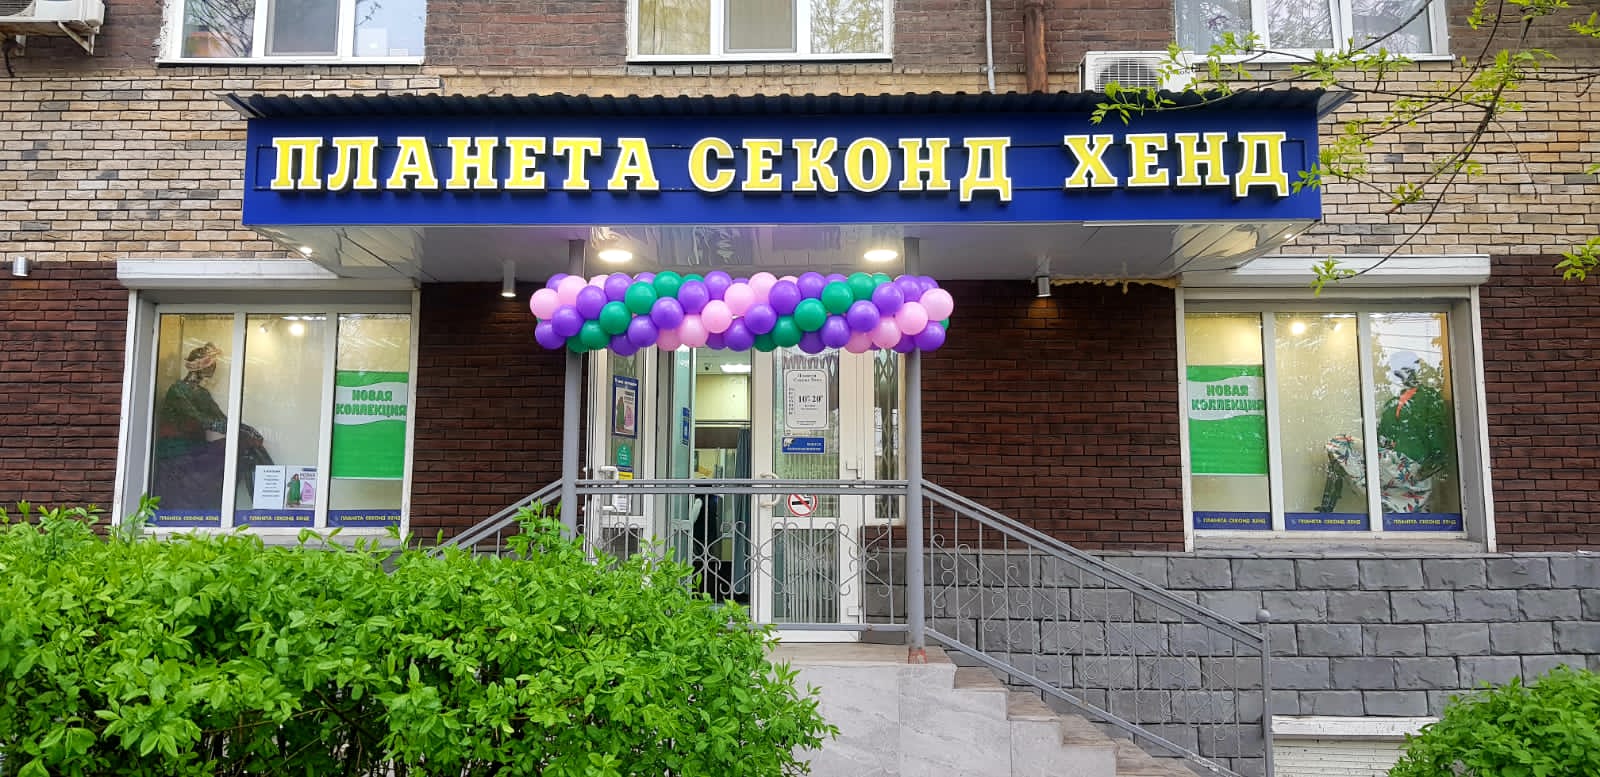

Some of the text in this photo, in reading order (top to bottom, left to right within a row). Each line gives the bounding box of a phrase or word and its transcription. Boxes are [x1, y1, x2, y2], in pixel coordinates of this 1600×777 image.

[270, 131, 1290, 203] ПЛАНЕТА СЕКОНД ХЕНД
[352, 390, 392, 401] НОВАЯ
[1206, 384, 1248, 396] НОВАЯ
[336, 403, 407, 417] КОЛЛЕКЦИЯ
